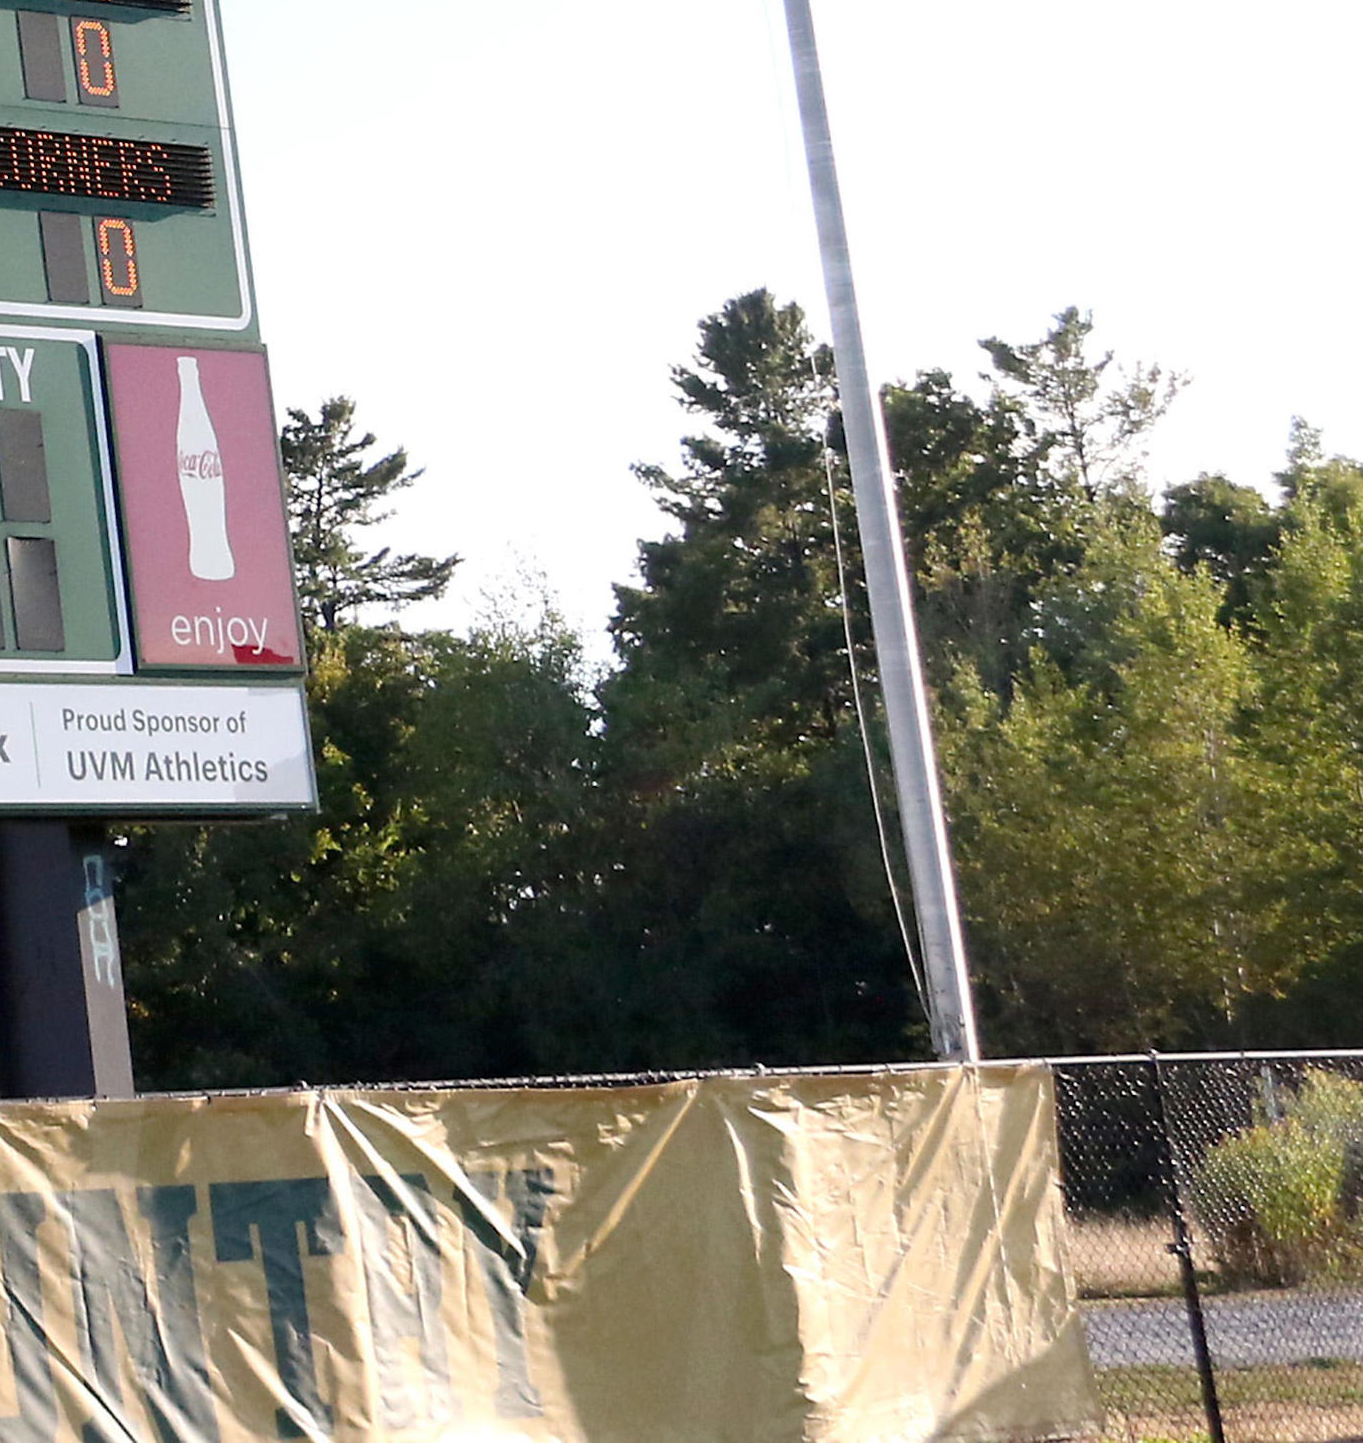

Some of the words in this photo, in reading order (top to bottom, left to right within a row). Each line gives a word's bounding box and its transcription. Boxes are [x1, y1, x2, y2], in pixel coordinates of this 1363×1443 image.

[75, 20, 115, 98] 0
[98, 218, 140, 297] 0
[171, 607, 269, 655] enjoy
[62, 707, 128, 732] Proud
[132, 709, 221, 737] Sponsor
[226, 710, 247, 734] of
[67, 750, 137, 782] UVM
[144, 750, 269, 783] Athletics
